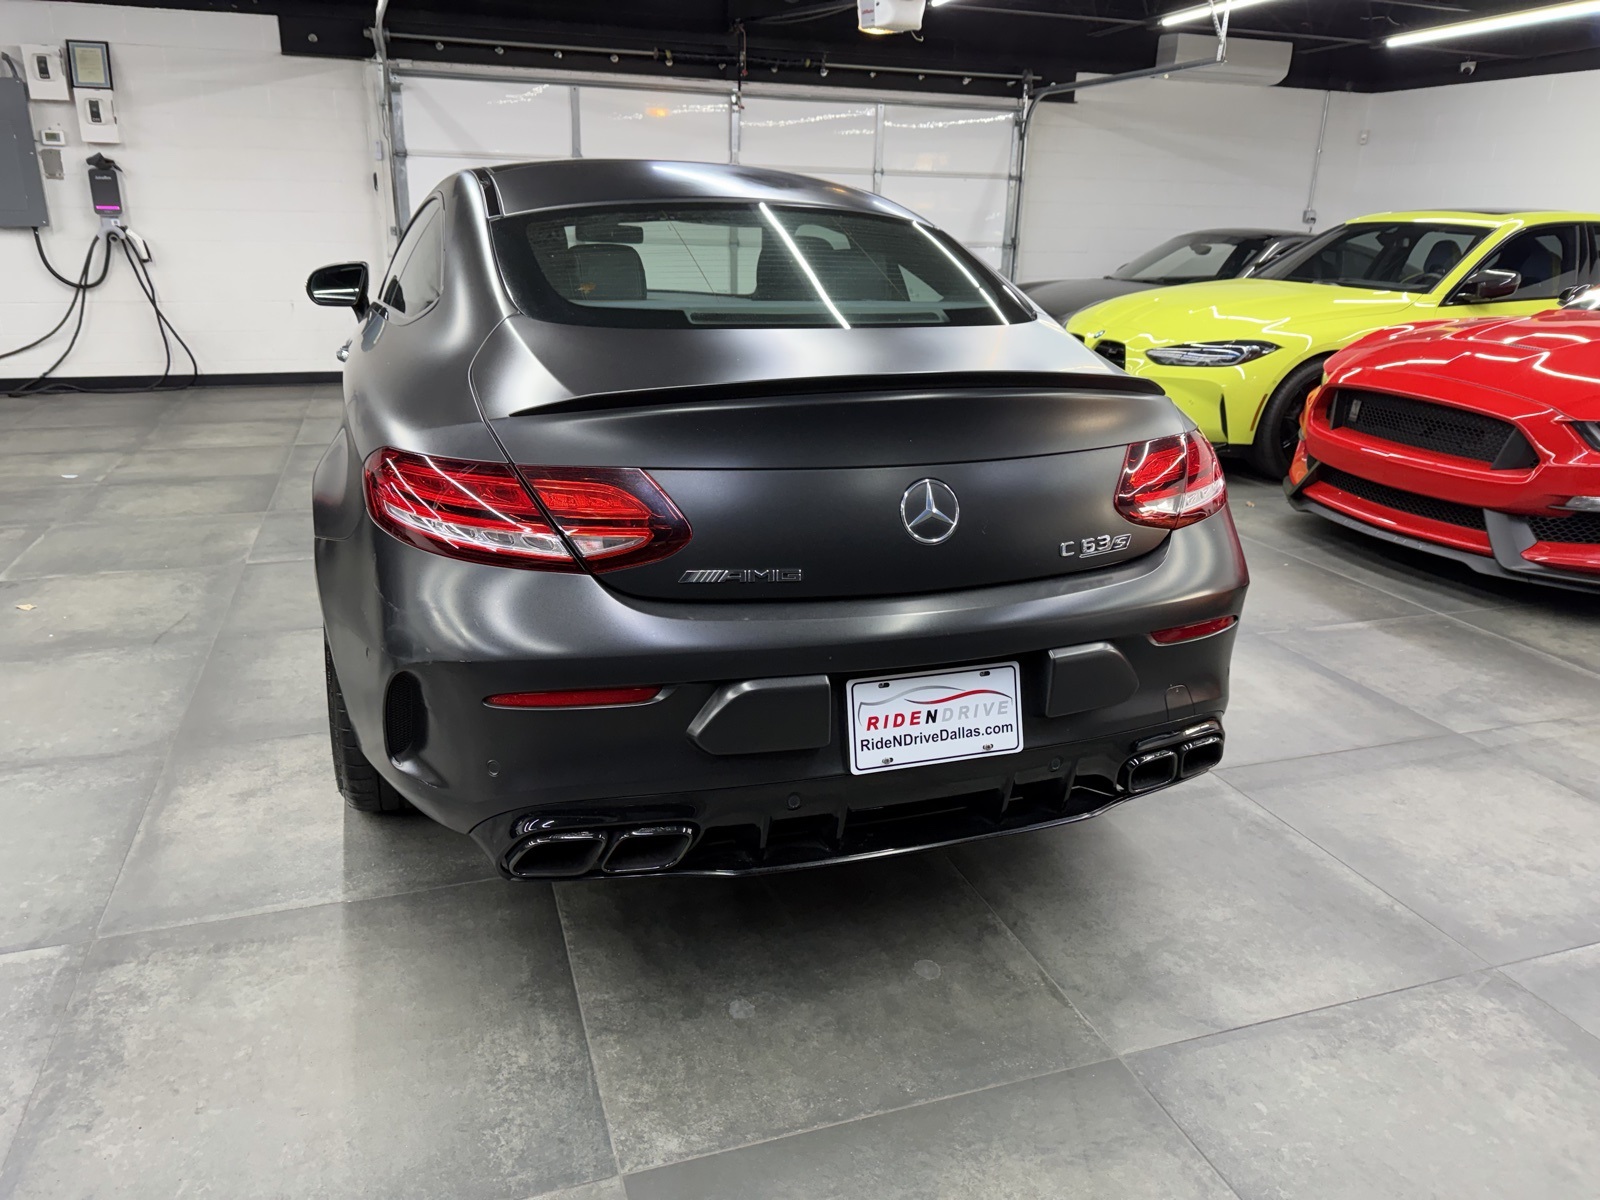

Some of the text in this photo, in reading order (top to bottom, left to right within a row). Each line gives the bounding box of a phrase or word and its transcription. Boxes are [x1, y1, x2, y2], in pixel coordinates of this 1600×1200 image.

[1060, 541, 1075, 557] C
[717, 569, 802, 582] AMG
[860, 723, 1013, 752] RideNDriveDallas.com
